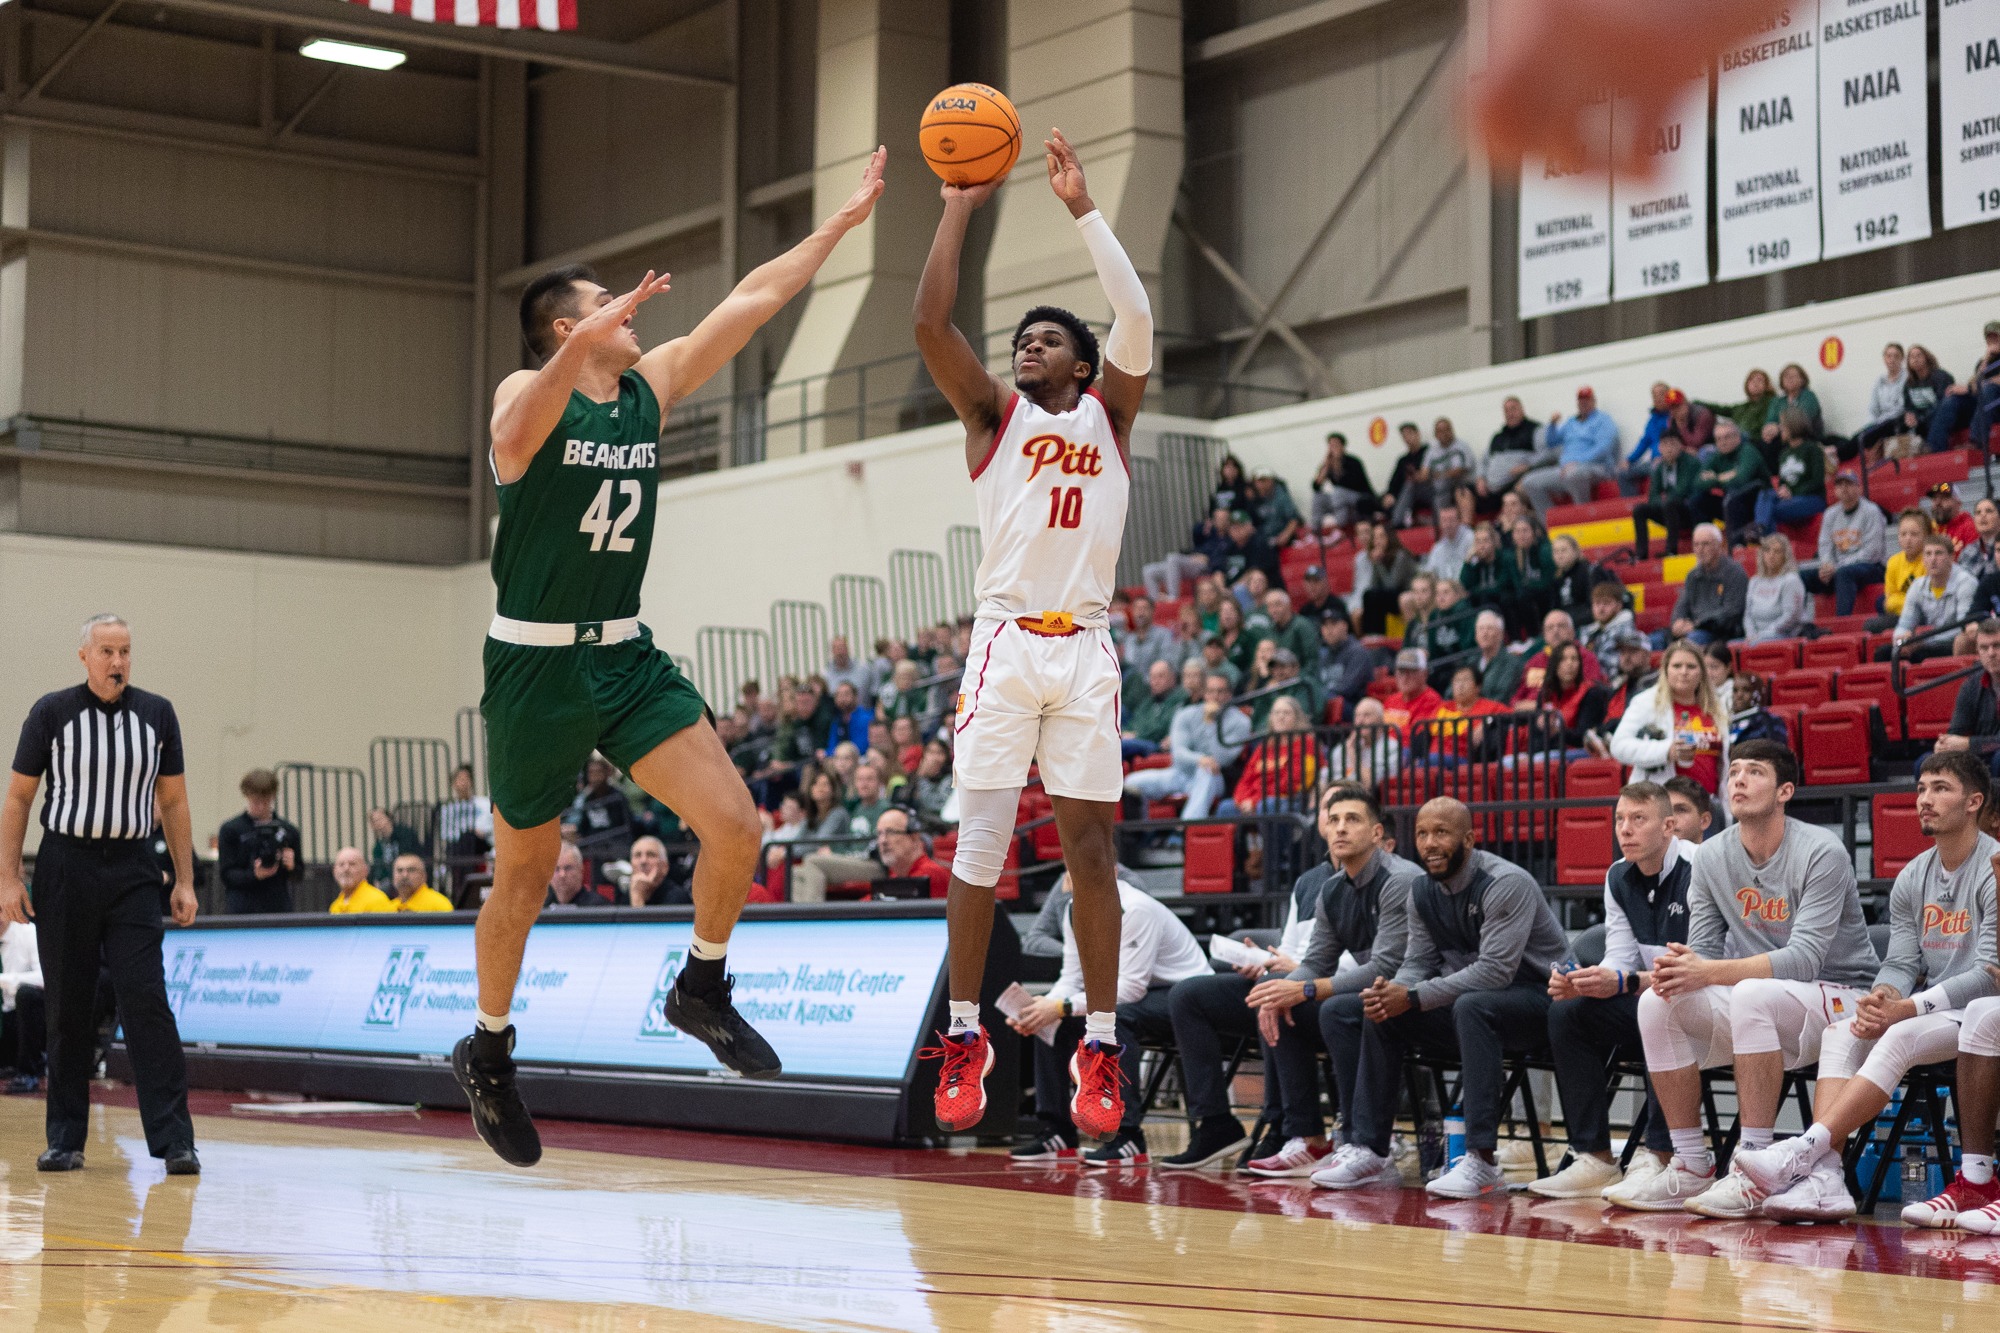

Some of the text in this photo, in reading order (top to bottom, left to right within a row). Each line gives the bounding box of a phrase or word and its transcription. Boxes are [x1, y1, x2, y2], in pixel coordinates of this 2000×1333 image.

[1823, 0, 1921, 43] BASKETBALL
[1722, 31, 1813, 73] BASKETBALL
[1843, 65, 1901, 108] NAIA
[932, 97, 977, 113] NCAA
[1740, 95, 1794, 134] NAIA
[1650, 123, 1682, 157] AU
[1840, 140, 1910, 173] NATIONAL
[1735, 167, 1800, 197] NATIONAL
[1629, 192, 1692, 220] NATIONAL
[1855, 213, 1899, 243] 1942
[1748, 237, 1791, 266] 1940
[1642, 259, 1681, 286] 1928
[563, 439, 656, 469] BEARCATS
[1022, 433, 1103, 483] Pitt
[579, 479, 642, 552] 42
[1047, 486, 1083, 529] 10
[1922, 904, 1973, 937] Pitt
[791, 963, 846, 994] Health
[847, 968, 904, 997] Center
[792, 997, 856, 1025] Kansas
